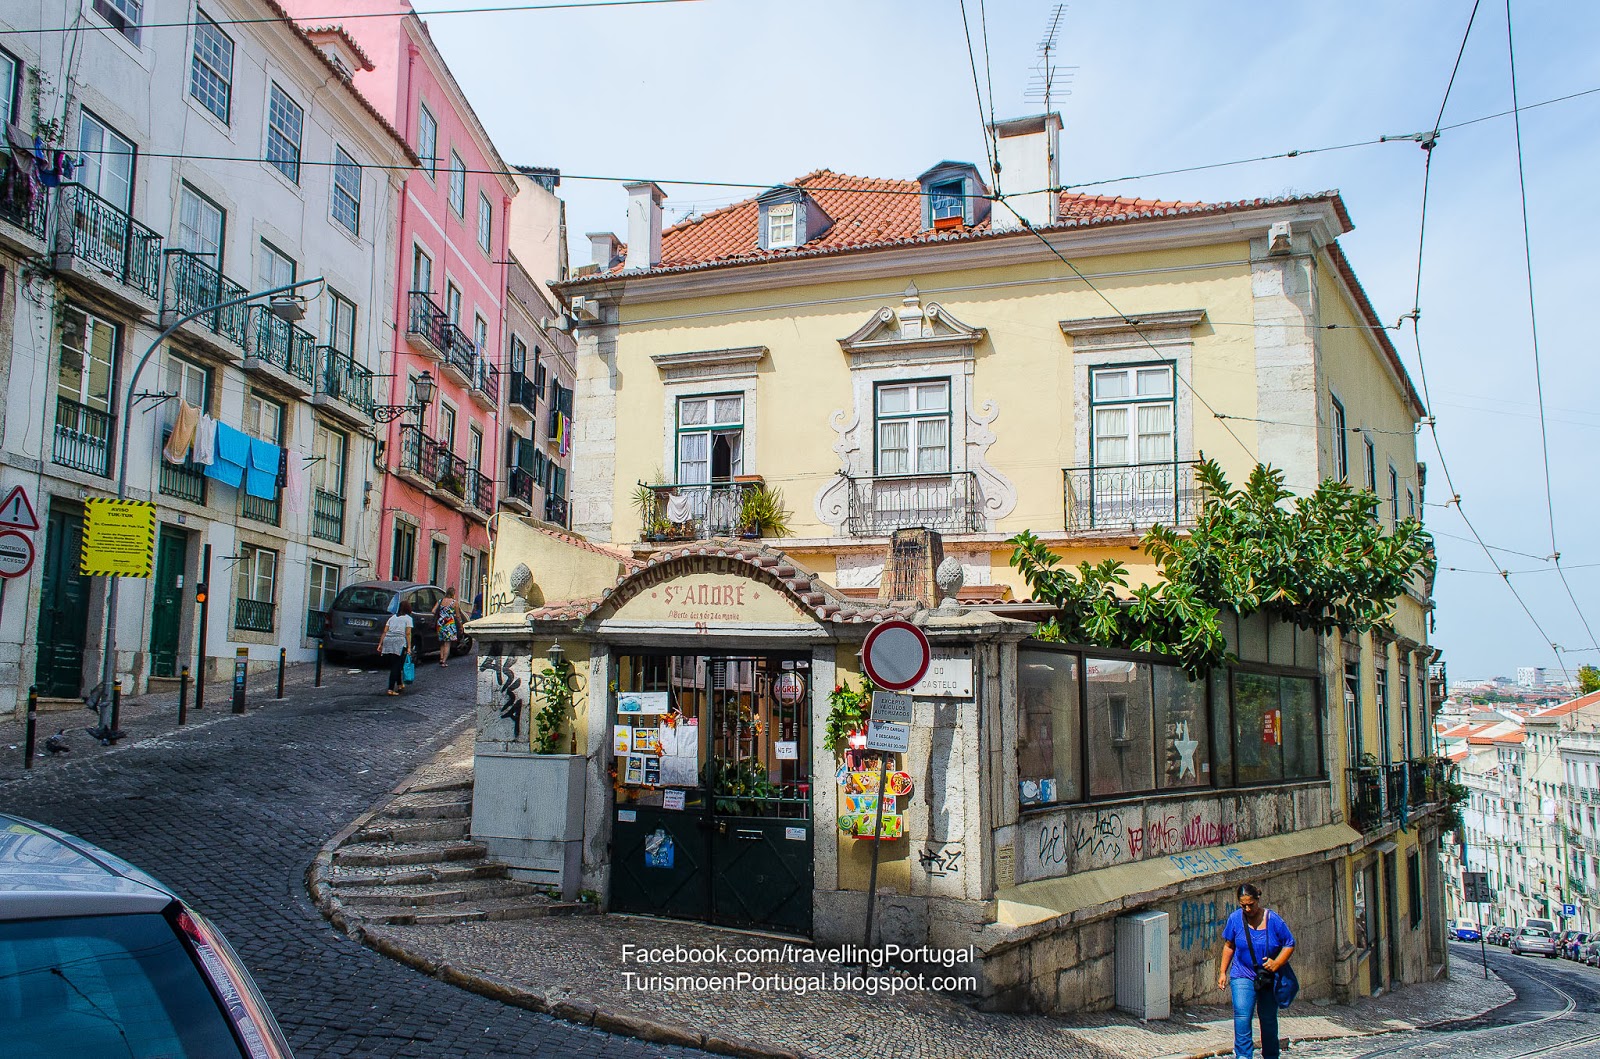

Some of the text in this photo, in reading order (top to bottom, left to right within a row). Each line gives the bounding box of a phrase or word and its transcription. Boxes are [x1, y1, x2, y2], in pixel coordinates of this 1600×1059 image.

[609, 555, 711, 611] RESTAURANTE
[931, 653, 952, 662] OSTA
[934, 667, 944, 675] DO
[922, 680, 957, 688] CASTELO
